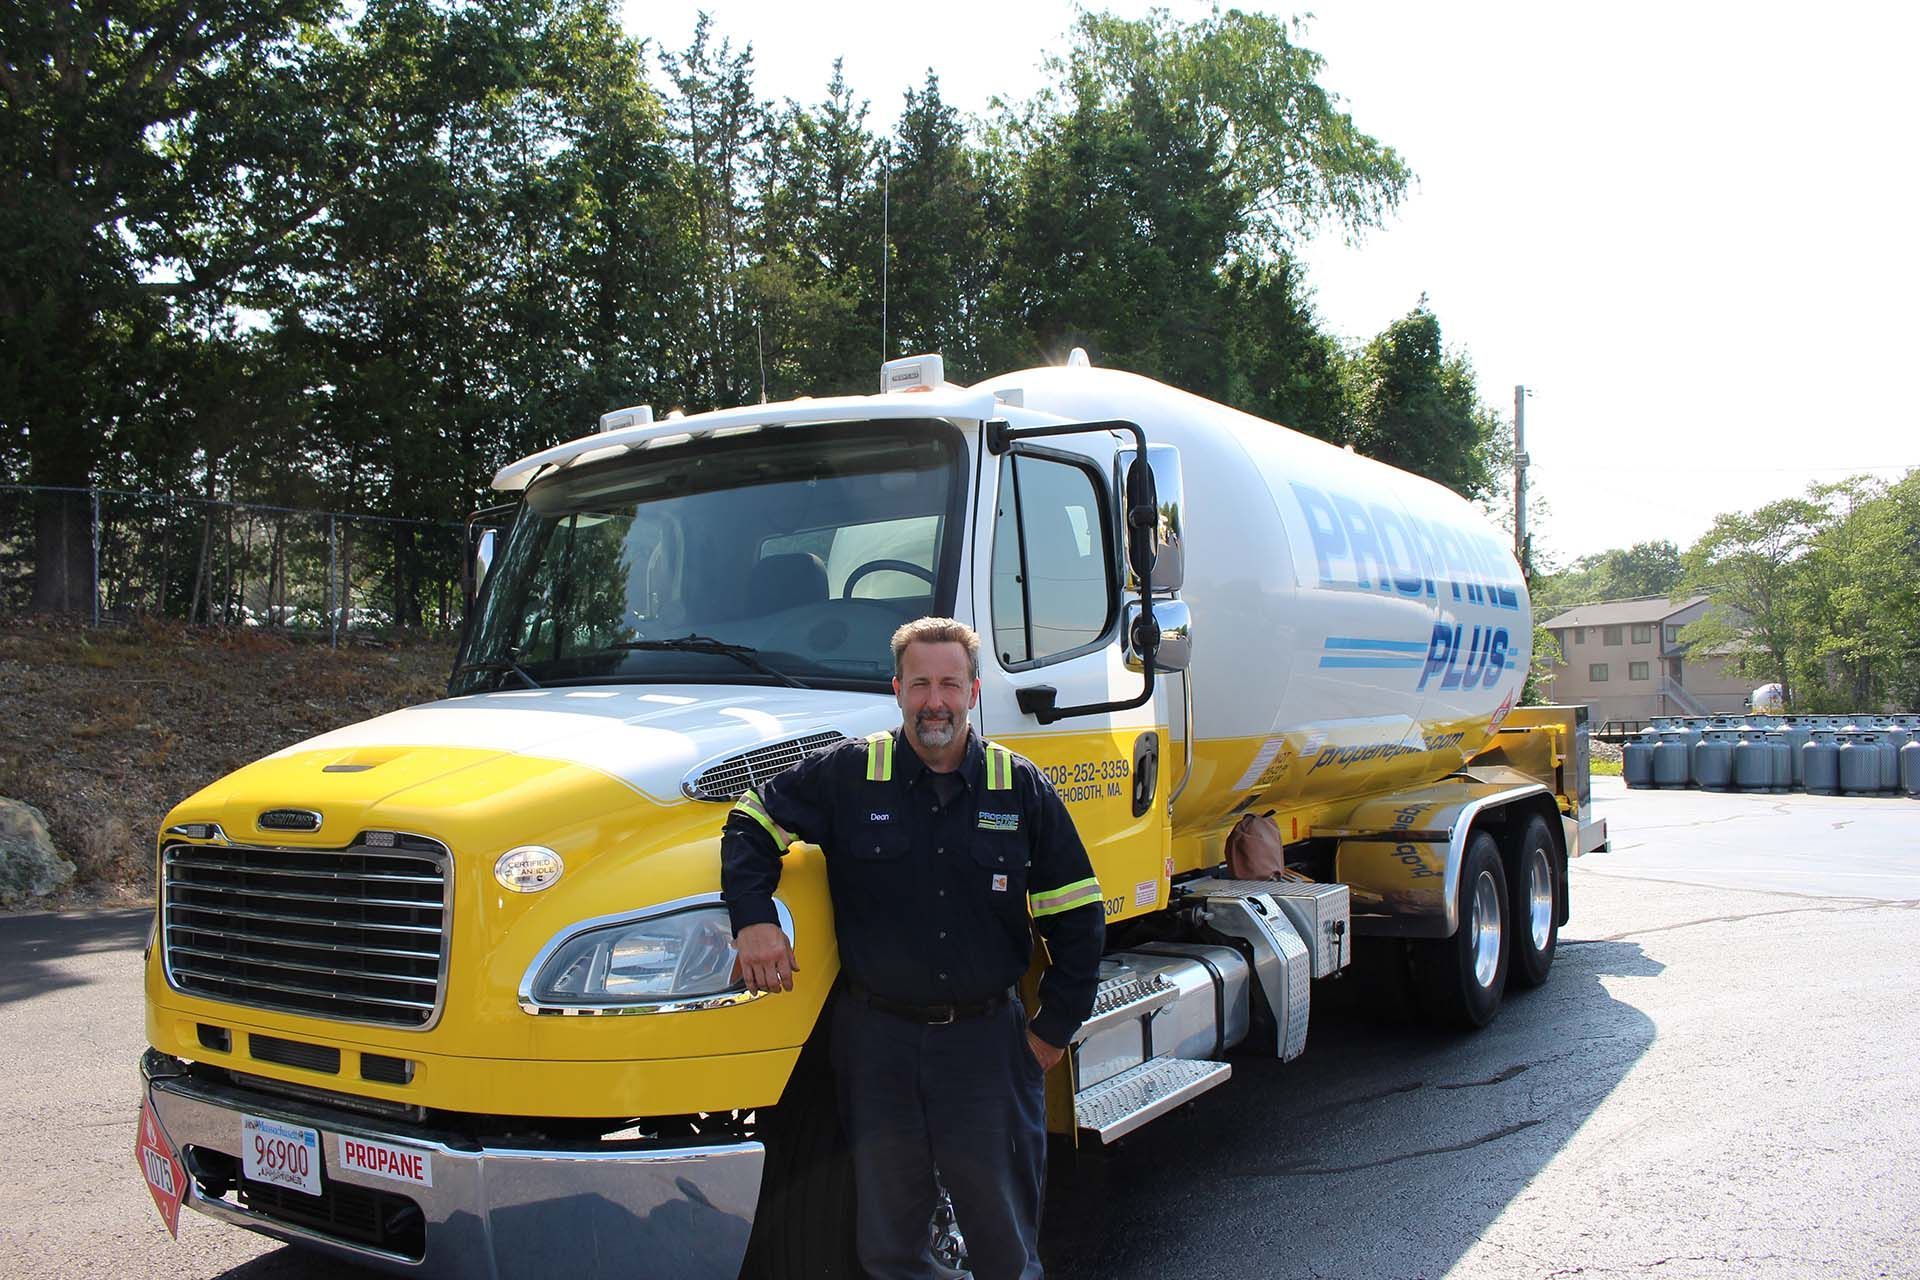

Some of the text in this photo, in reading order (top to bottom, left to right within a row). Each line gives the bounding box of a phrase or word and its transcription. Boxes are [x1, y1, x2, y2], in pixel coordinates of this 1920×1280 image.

[1416, 621, 1510, 692] PLUS
[1043, 760, 1129, 785] 508-252-3359
[1057, 783, 1122, 803] EHOBOTH, MA.
[1103, 896, 1125, 916] 307
[144, 1152, 173, 1193] 1075
[255, 1135, 308, 1176] 96900
[345, 1141, 424, 1180] PROPANE
